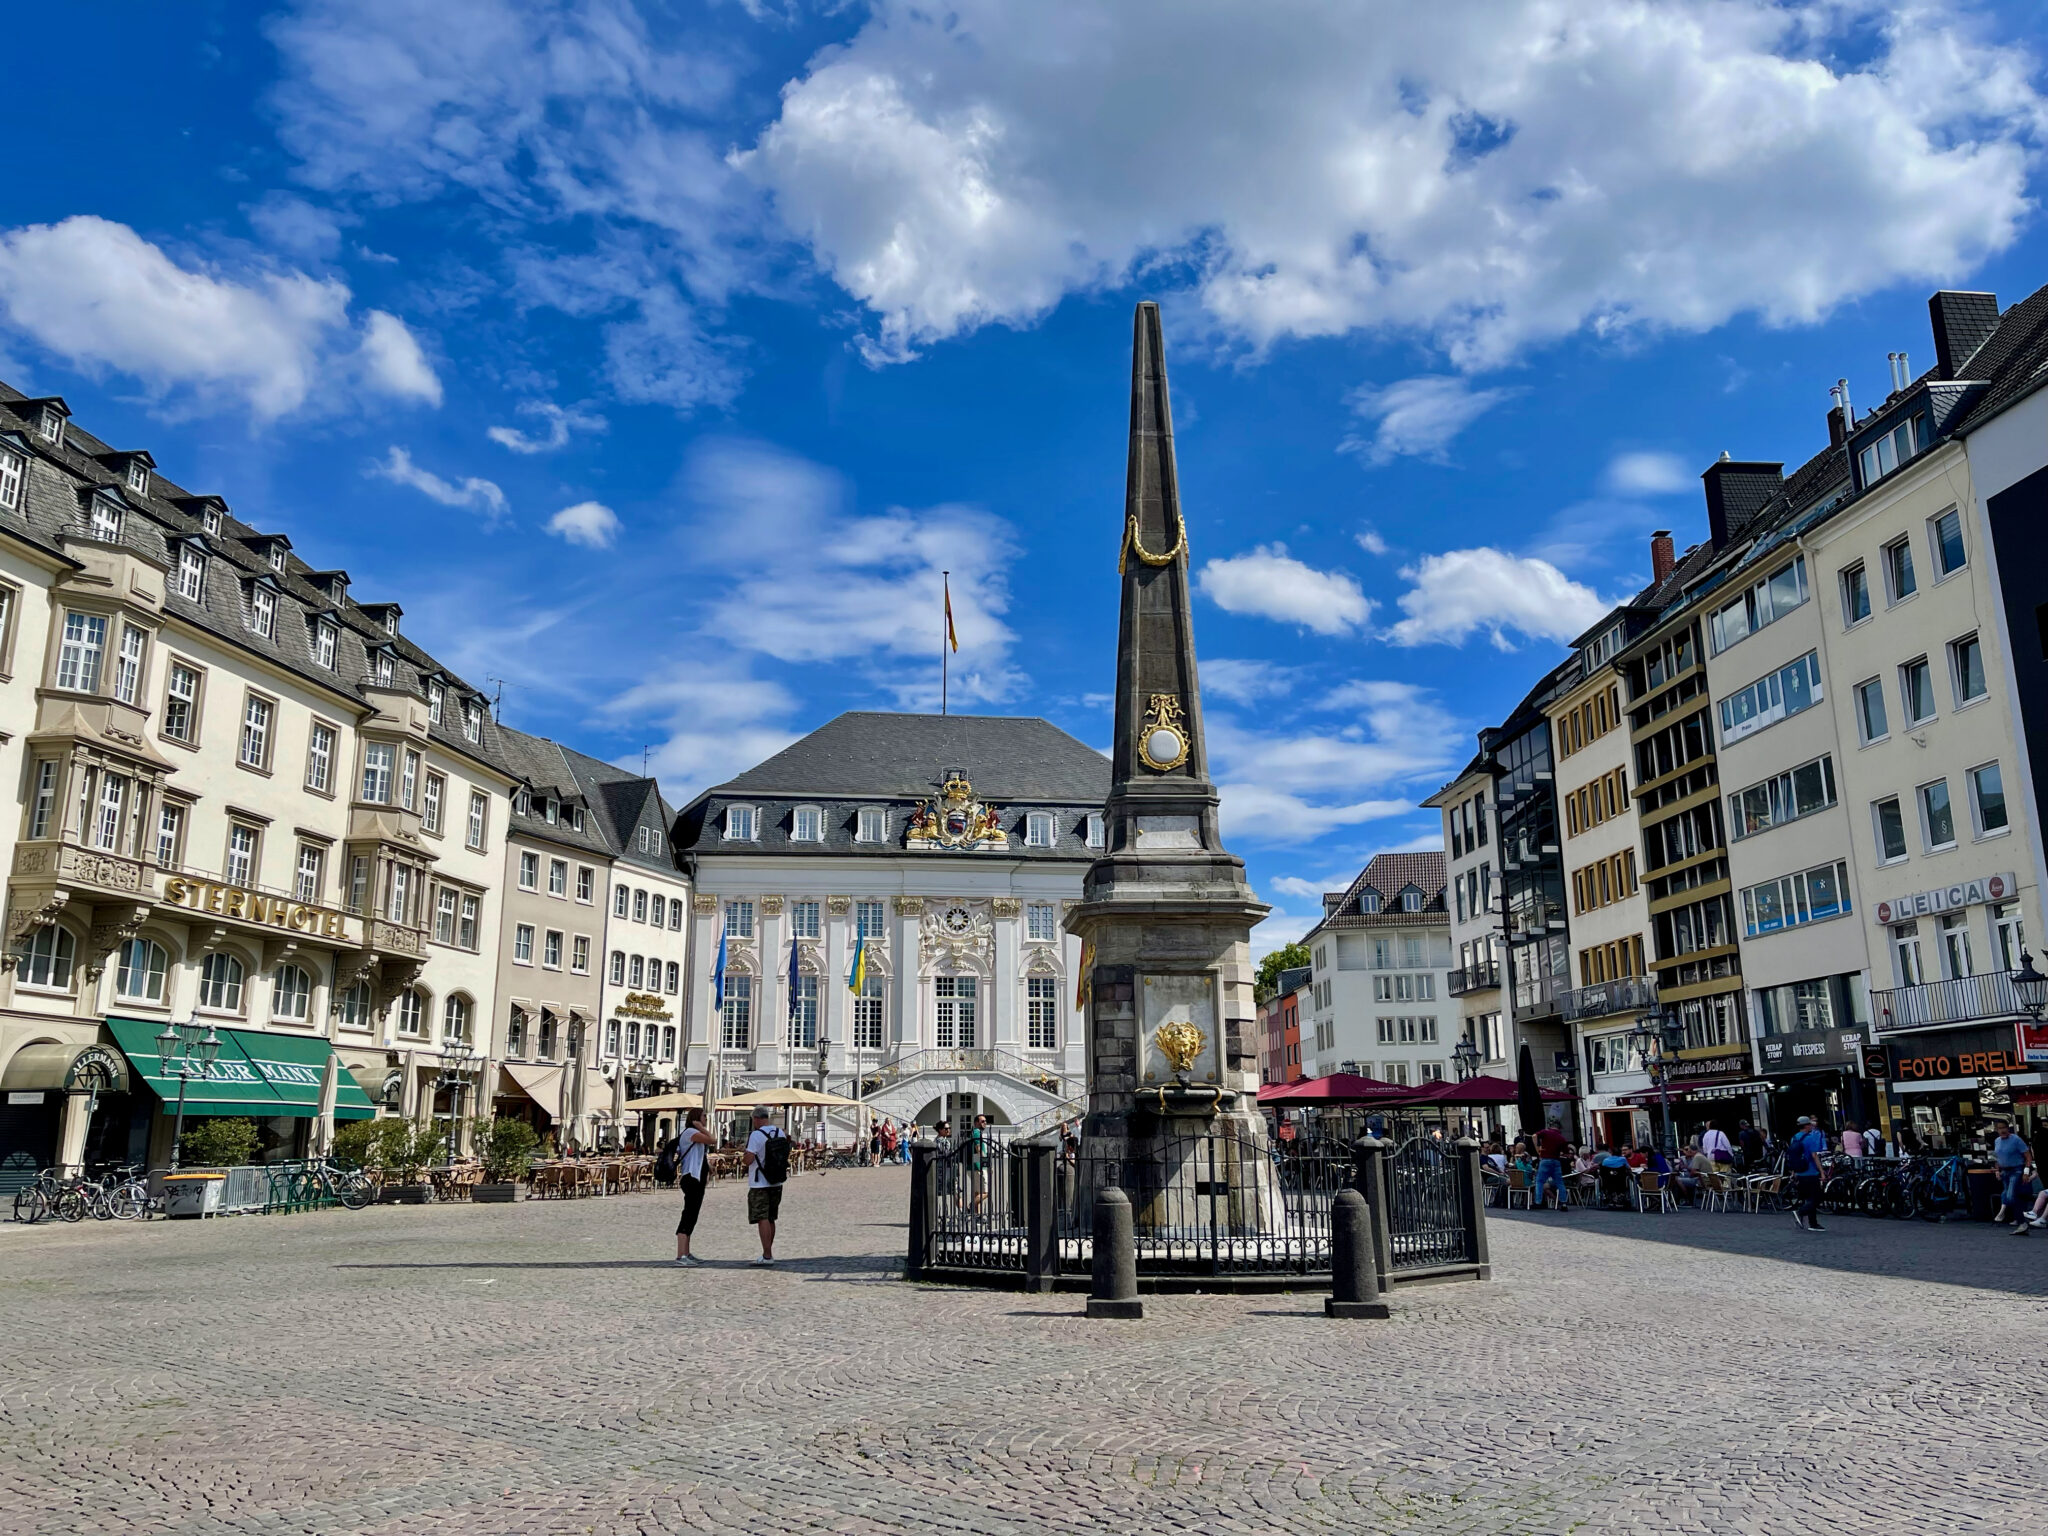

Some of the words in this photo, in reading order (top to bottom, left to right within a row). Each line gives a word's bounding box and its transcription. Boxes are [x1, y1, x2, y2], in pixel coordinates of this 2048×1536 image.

[164, 877, 350, 940] STERNHOTEL
[1899, 884, 1981, 916] LEICA
[1765, 1043, 1782, 1052] KEBAP
[1841, 1033, 1861, 1043] KEBAP
[1767, 1051, 1782, 1059] STORY
[1792, 1043, 1825, 1056] KÖFTESPIESS
[72, 1052, 119, 1078] ALLERMANN
[252, 1063, 320, 1083] MANN
[1899, 1056, 1950, 1078] FOTO
[1959, 1051, 2028, 1074] BRELL
